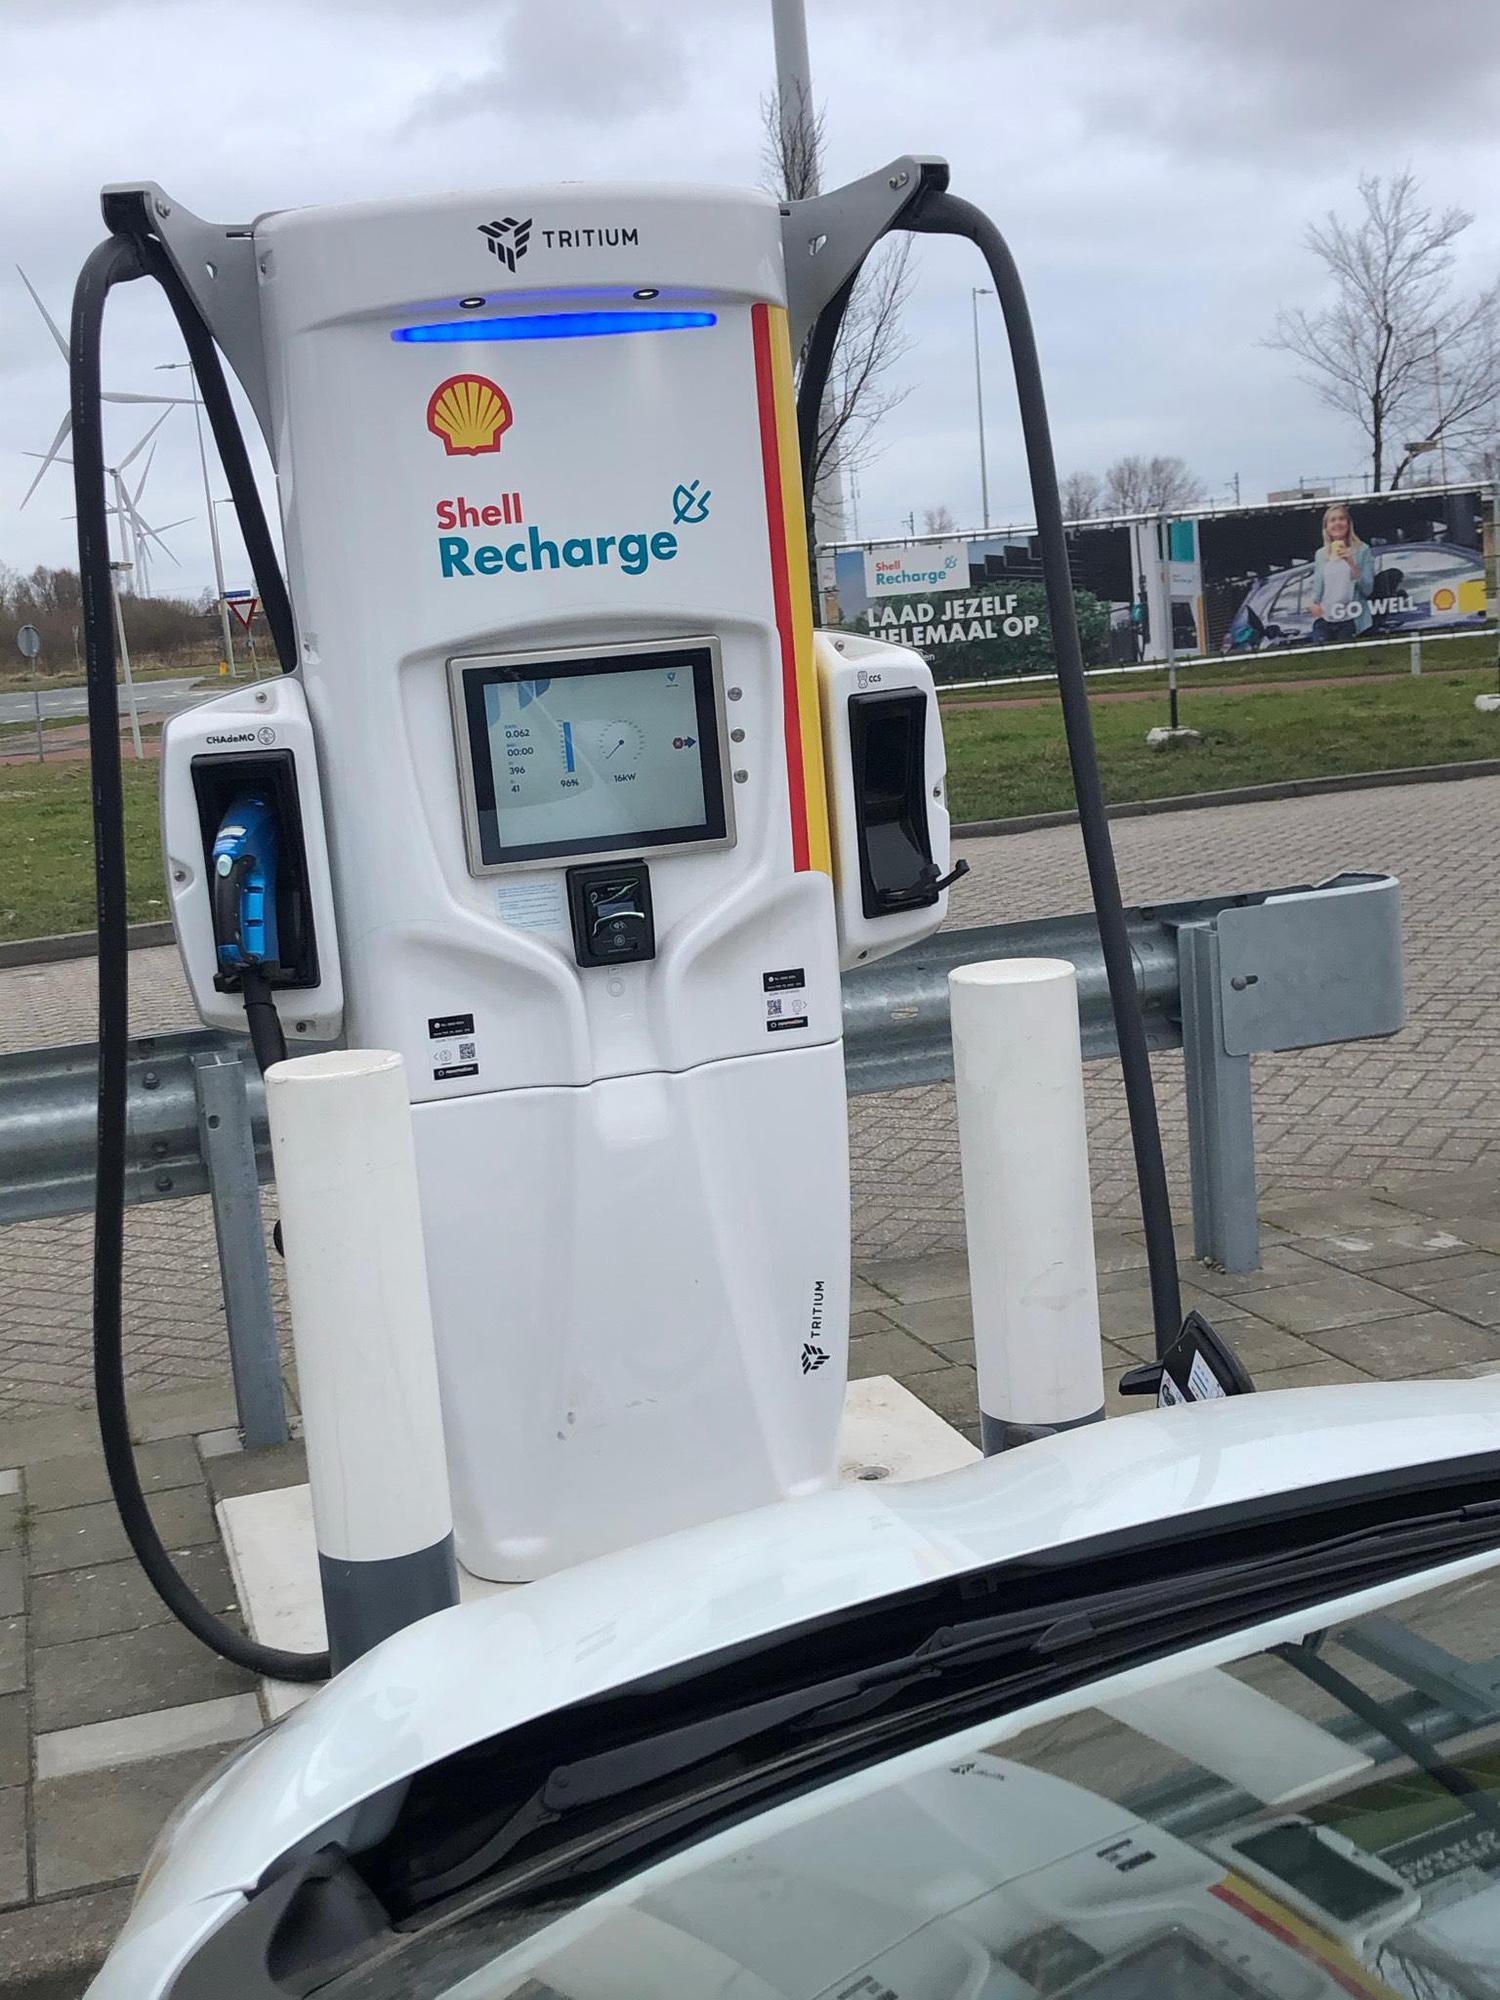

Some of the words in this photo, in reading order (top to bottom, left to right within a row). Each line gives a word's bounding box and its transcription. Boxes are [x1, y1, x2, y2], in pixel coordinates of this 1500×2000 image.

[542, 228, 639, 249] TRITIUM
[436, 492, 524, 530] Shell
[438, 526, 678, 578] Recharge
[875, 560, 901, 572] Shell
[876, 570, 947, 585] Recharge
[867, 603, 935, 628] LAAD
[941, 594, 1018, 621] JEZELF
[1331, 601, 1363, 619] GO
[1367, 596, 1418, 615] WELL
[1003, 615, 1039, 637] OP
[868, 674, 882, 683] CCS
[206, 733, 256, 745] CHAdeMO
[505, 729, 530, 739] 0.062
[507, 747, 534, 757] 00:00
[509, 766, 526, 775] 396
[613, 772, 636, 783] 16kW
[810, 1281, 825, 1339] TRITIUM
